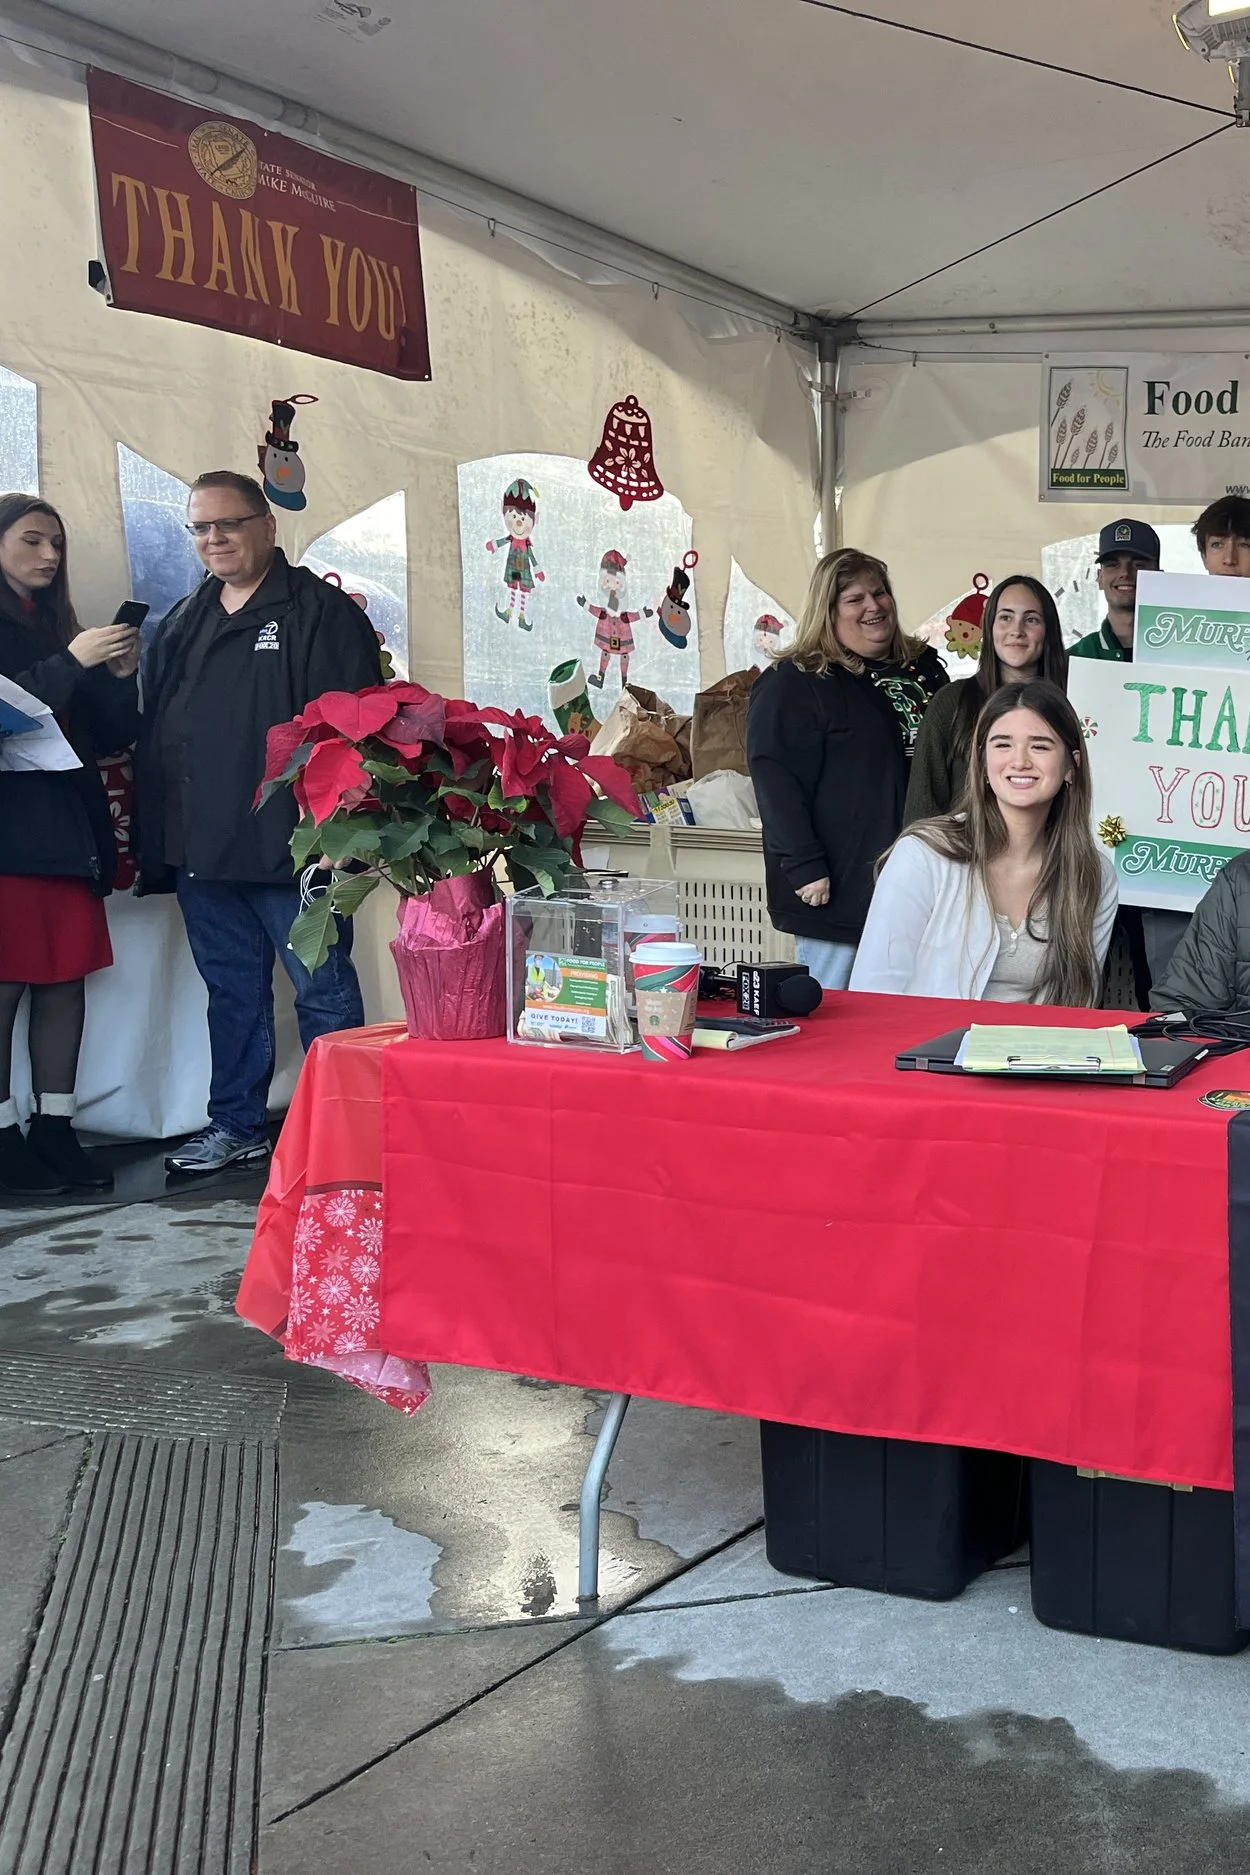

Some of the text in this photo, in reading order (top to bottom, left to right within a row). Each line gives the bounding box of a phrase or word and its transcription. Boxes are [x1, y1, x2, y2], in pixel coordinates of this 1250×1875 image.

[260, 161, 283, 175] TATE
[111, 172, 302, 317] THANK
[1142, 380, 1239, 416] Food
[1142, 430, 1169, 449] The
[1173, 430, 1213, 449] Food
[1052, 473, 1125, 486] Food for People
[1121, 841, 1233, 884] MURP
[530, 1013, 549, 1021] GIVE
[551, 1015, 578, 1024] TODAY!
